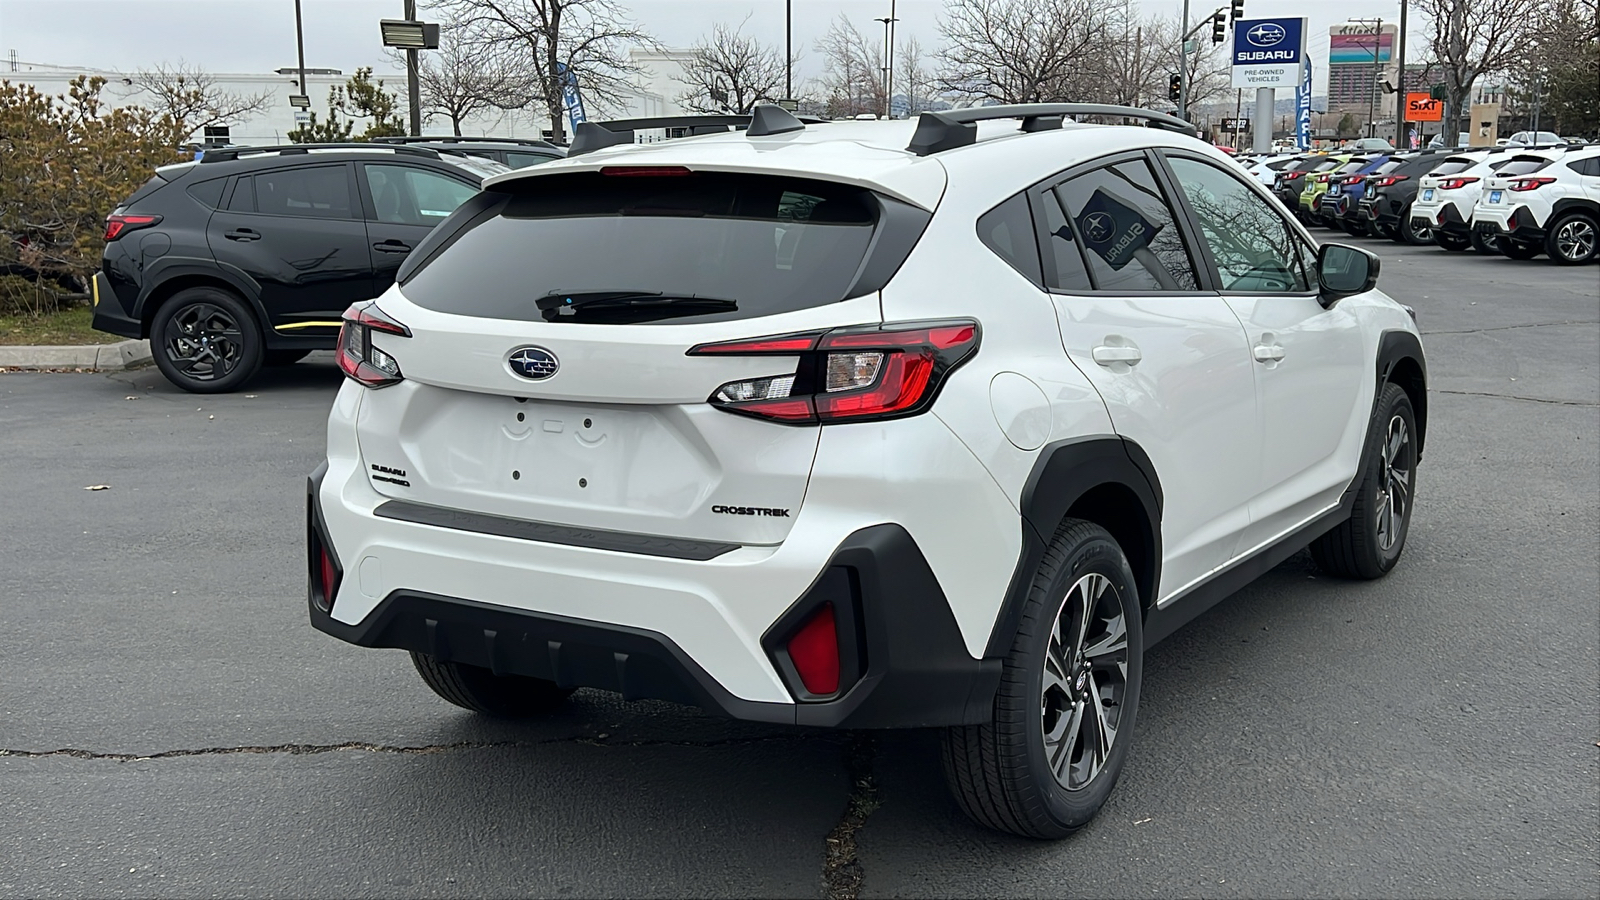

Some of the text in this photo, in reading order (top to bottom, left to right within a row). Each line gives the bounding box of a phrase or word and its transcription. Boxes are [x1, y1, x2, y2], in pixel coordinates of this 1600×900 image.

[1237, 50, 1294, 61] SUBARU
[371, 463, 406, 477] SUBARU
[711, 505, 790, 518] CROSSTREK
